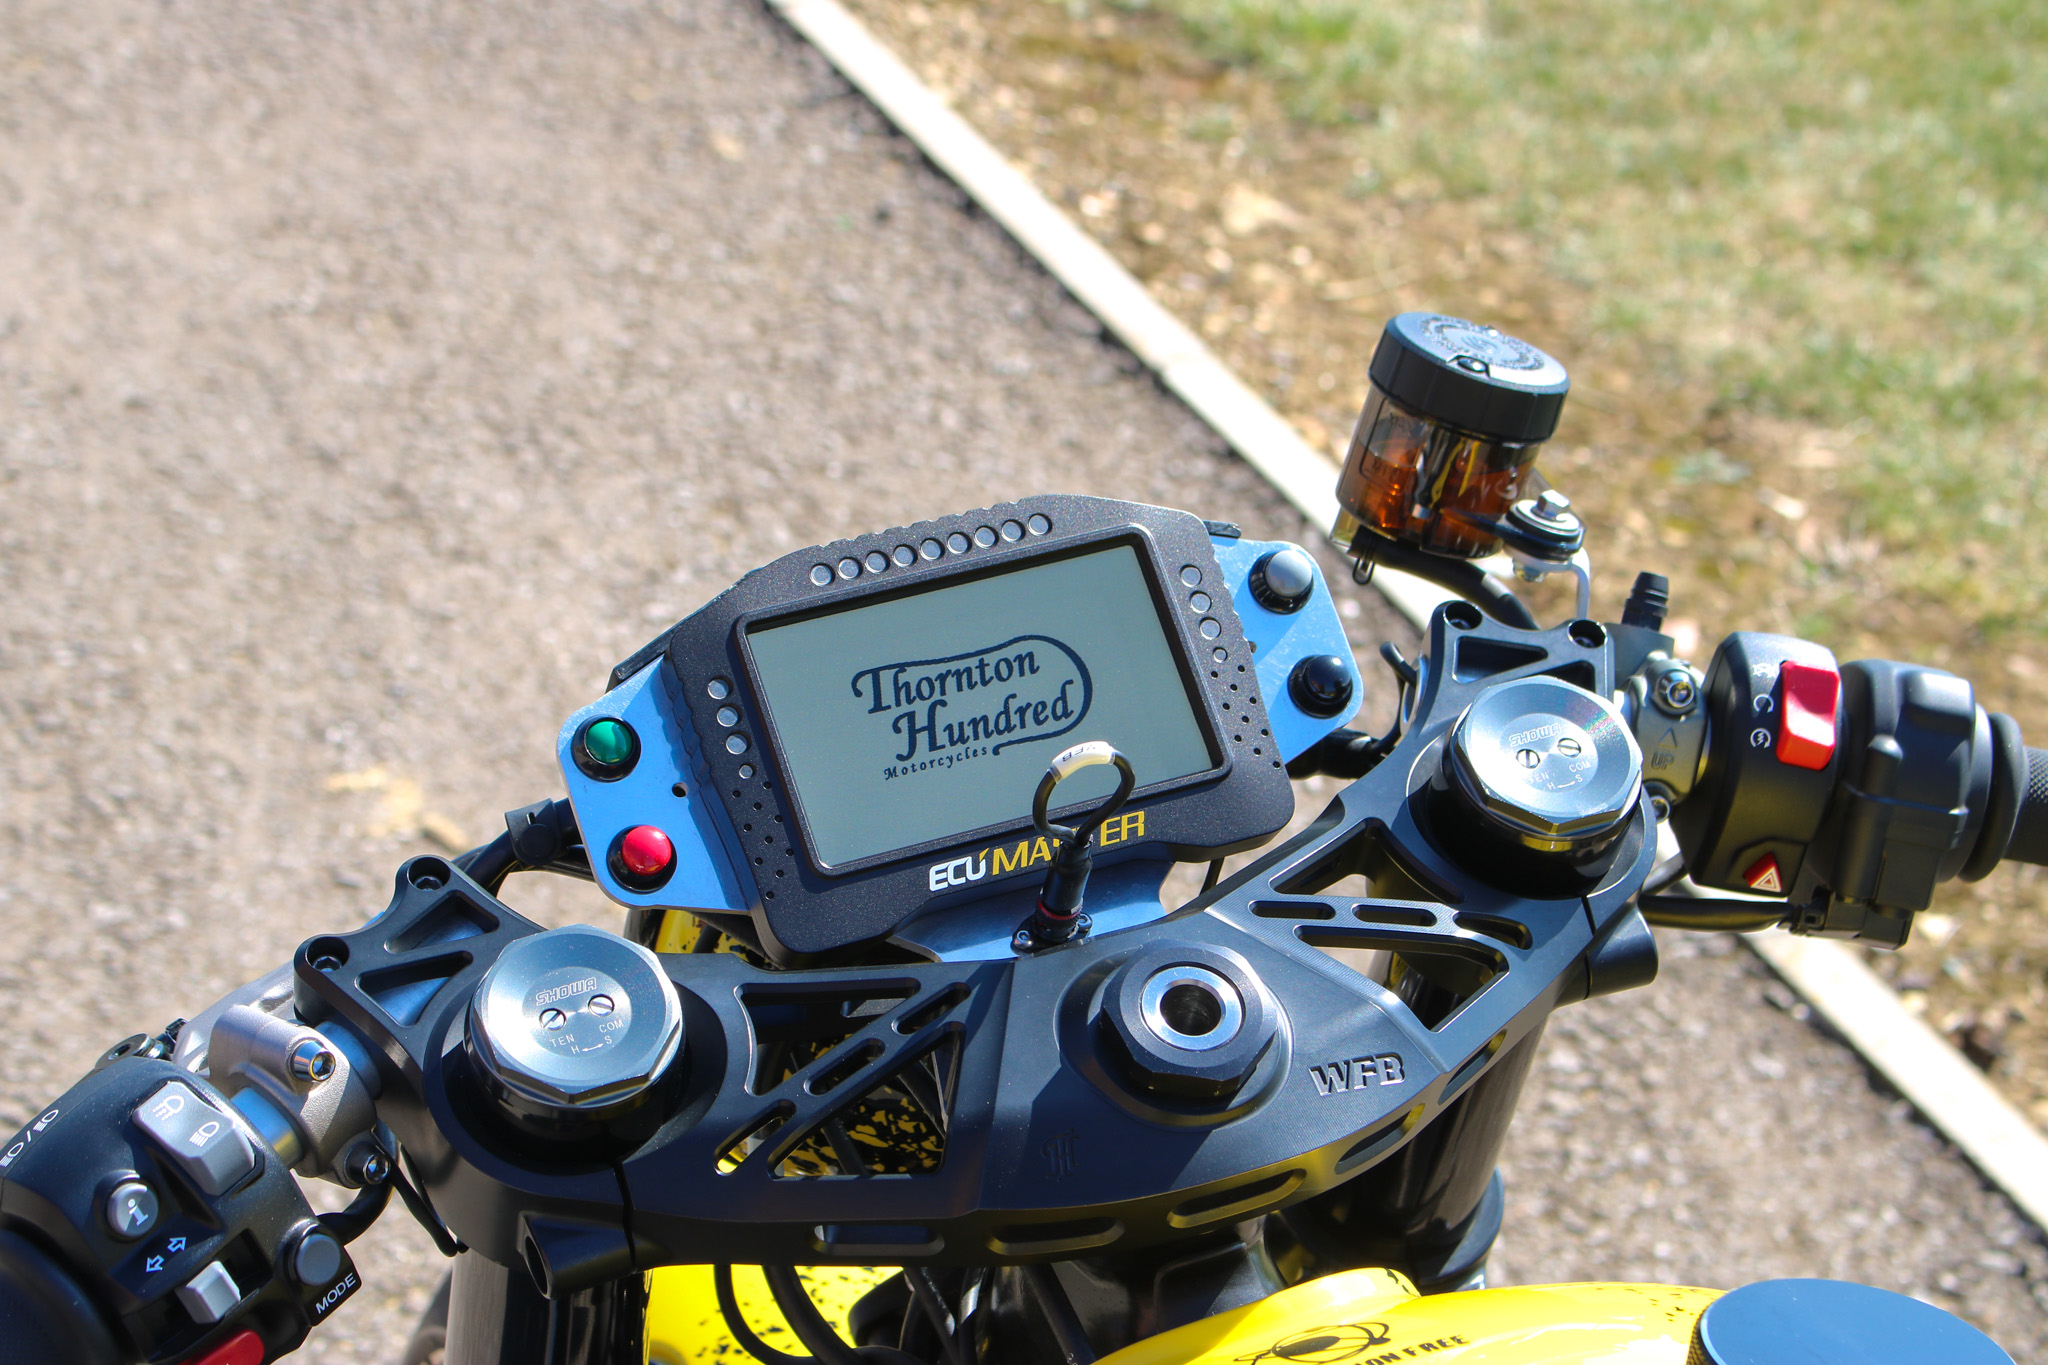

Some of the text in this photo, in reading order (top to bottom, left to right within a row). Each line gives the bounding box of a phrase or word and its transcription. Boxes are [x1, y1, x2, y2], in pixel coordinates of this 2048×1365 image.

[851, 650, 1041, 714] Thornton
[892, 679, 1074, 762] Hundred
[1508, 722, 1563, 748] SHOWA
[884, 745, 989, 780] Motorcycles
[1569, 761, 1591, 772] COM
[1650, 751, 1675, 770] UP
[1546, 773, 1583, 791] H S
[929, 810, 1146, 892] ECUMAER
[536, 977, 597, 1006] SHOWA
[599, 1020, 624, 1033] COM
[551, 1034, 575, 1048] TEN
[571, 1036, 612, 1055] H S
[1308, 1051, 1406, 1097] WFB
[315, 1271, 358, 1315] MODE
[1401, 1334, 1470, 1357] FREE
